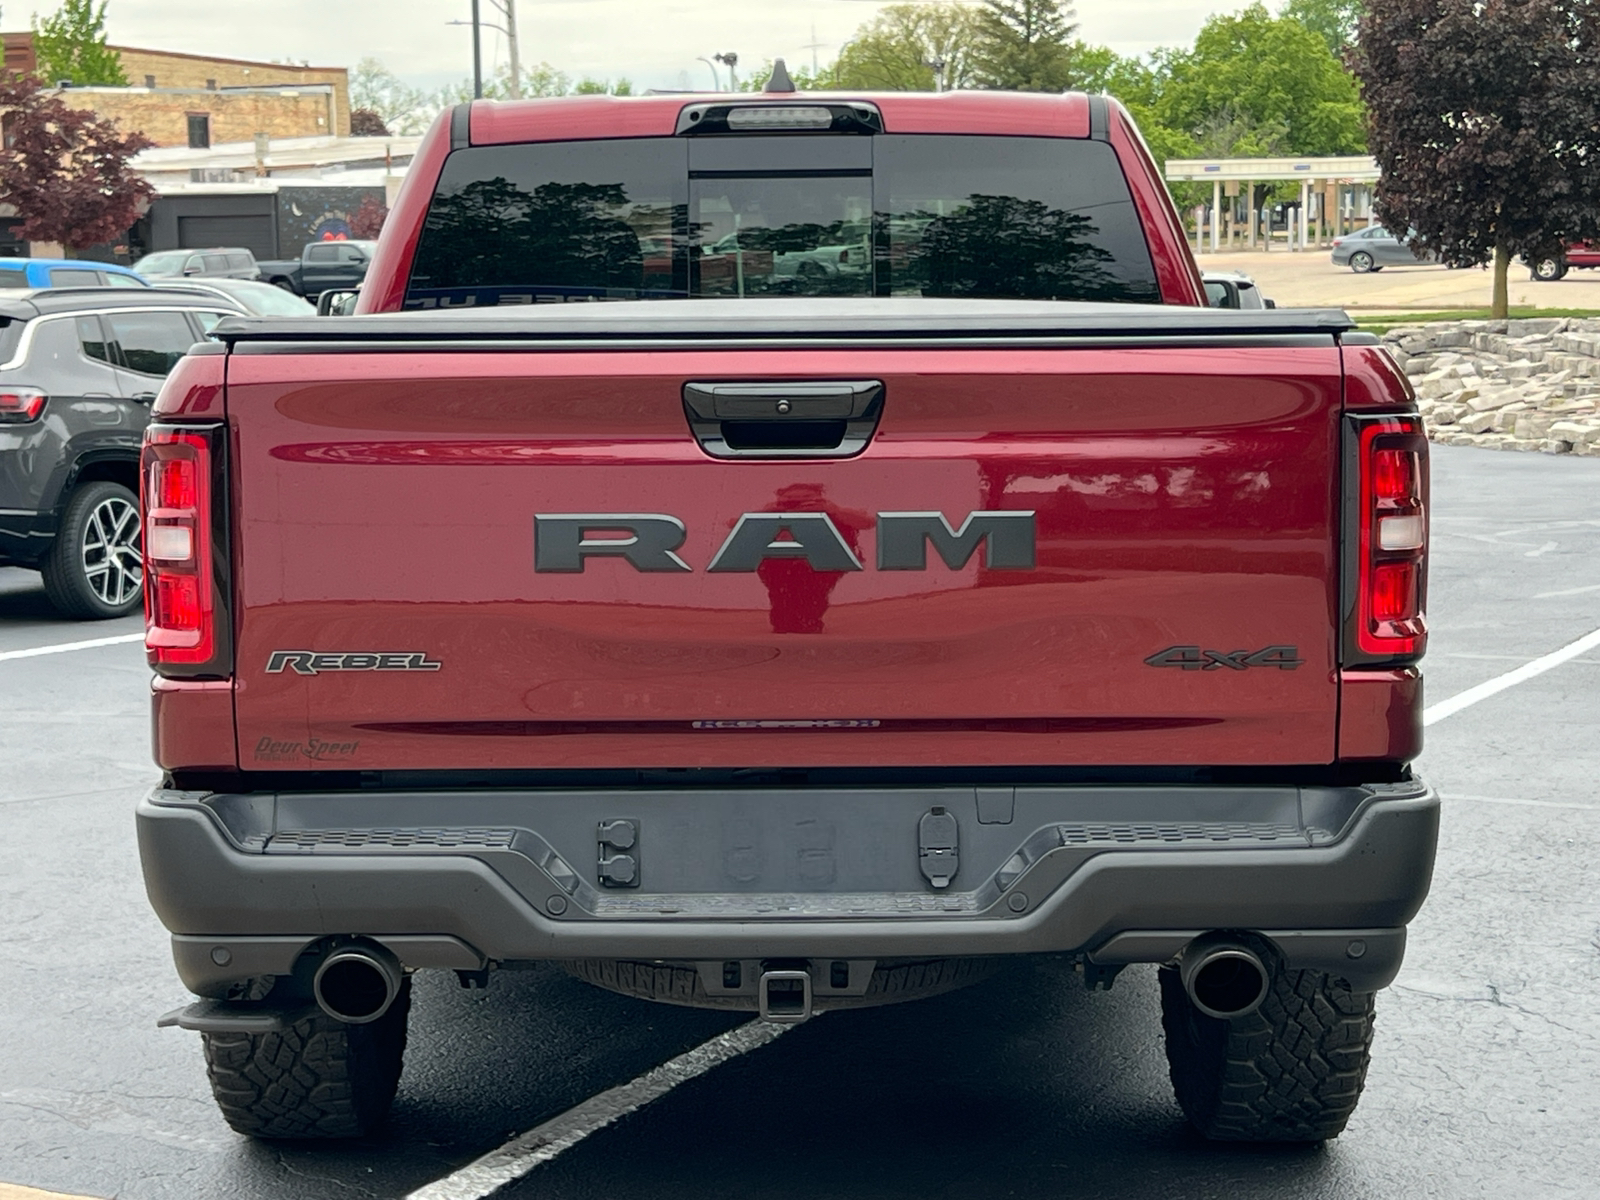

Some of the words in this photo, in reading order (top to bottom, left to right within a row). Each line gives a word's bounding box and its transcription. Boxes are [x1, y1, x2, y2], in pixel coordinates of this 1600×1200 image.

[533, 510, 1037, 573] RAM
[264, 650, 442, 675] REBEL
[255, 736, 302, 754] Deur
[302, 738, 360, 759] Speet
